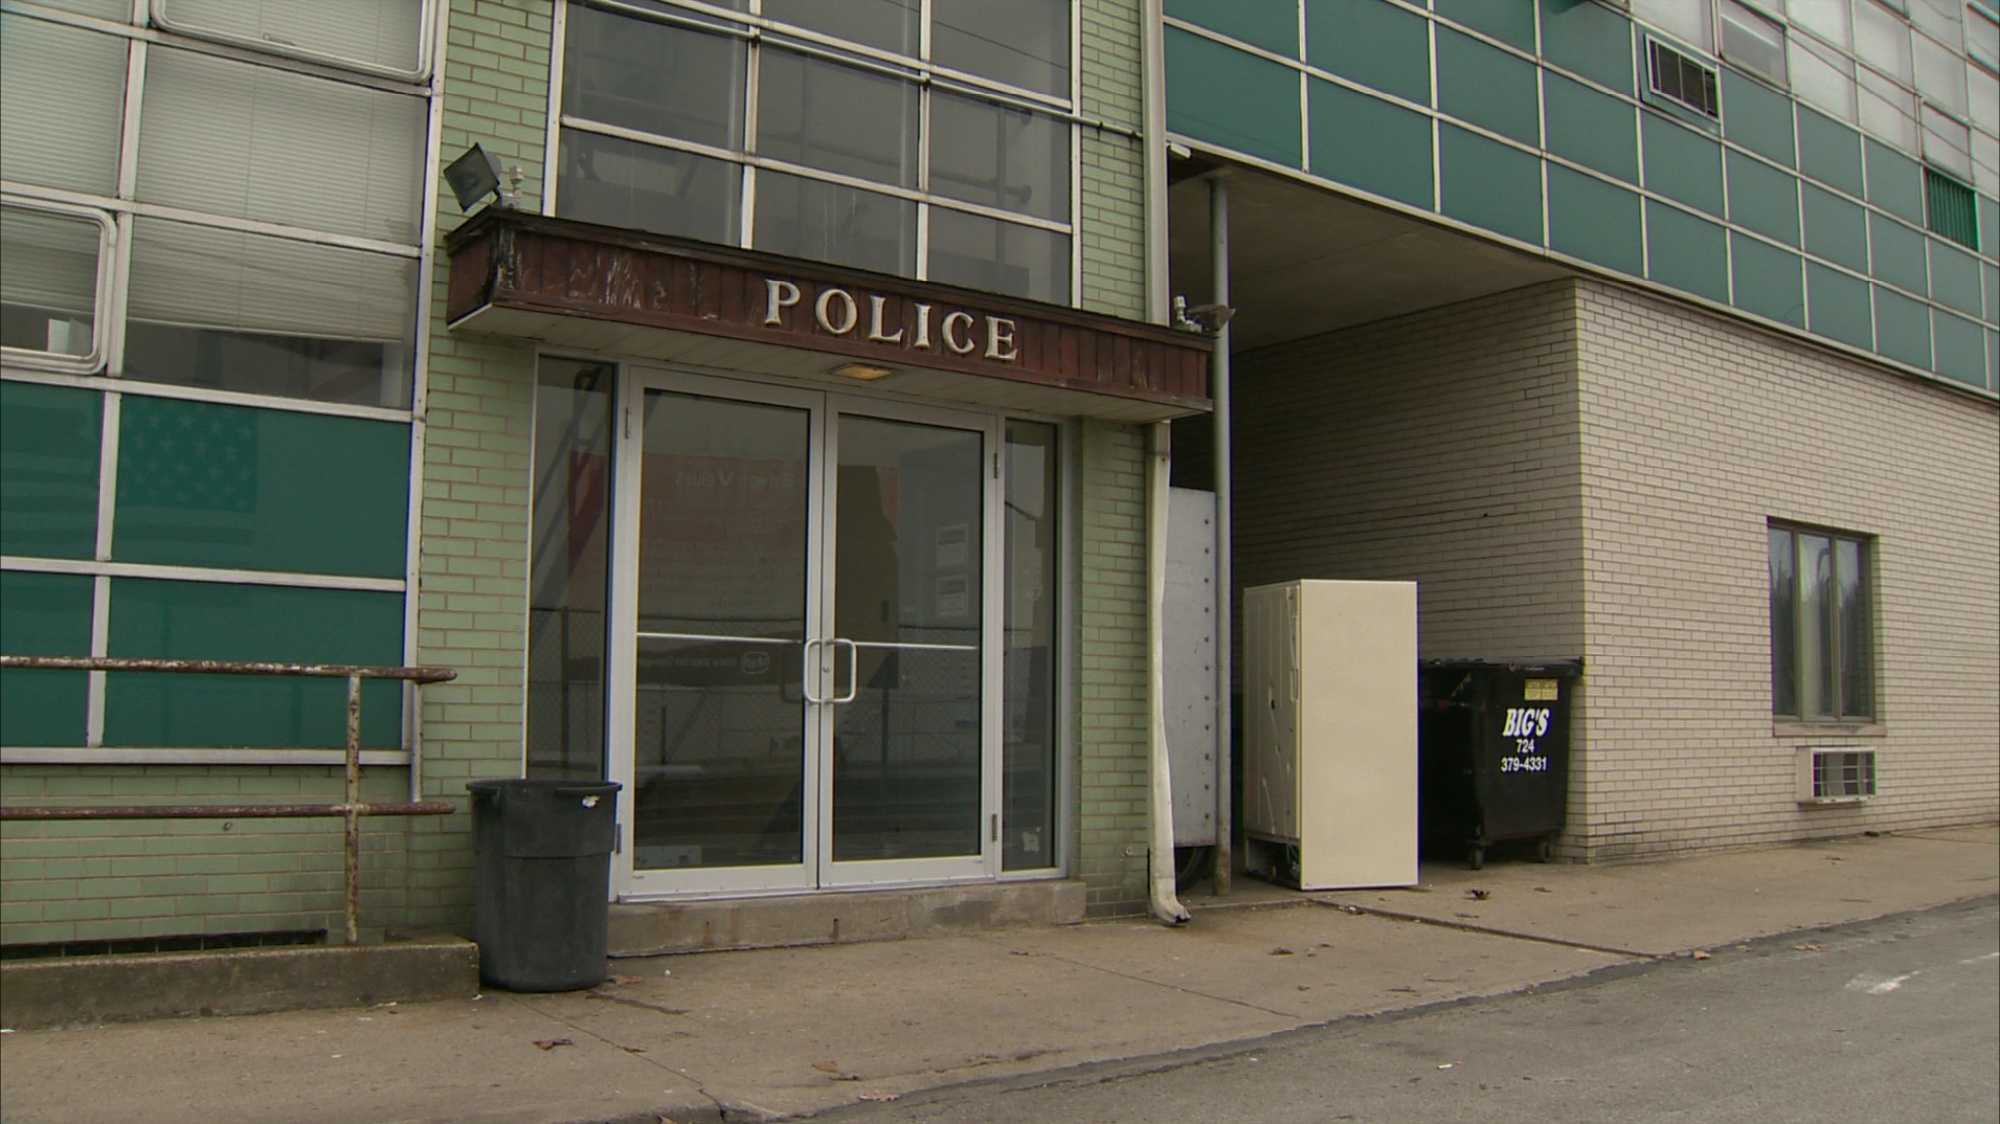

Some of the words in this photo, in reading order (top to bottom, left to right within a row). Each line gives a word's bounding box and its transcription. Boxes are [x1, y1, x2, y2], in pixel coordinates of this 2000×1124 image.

[764, 279, 1018, 361] POLICE
[1503, 708, 1549, 736] BIG'S
[1516, 739, 1535, 753] 724
[1501, 757, 1547, 771] 379-4331
